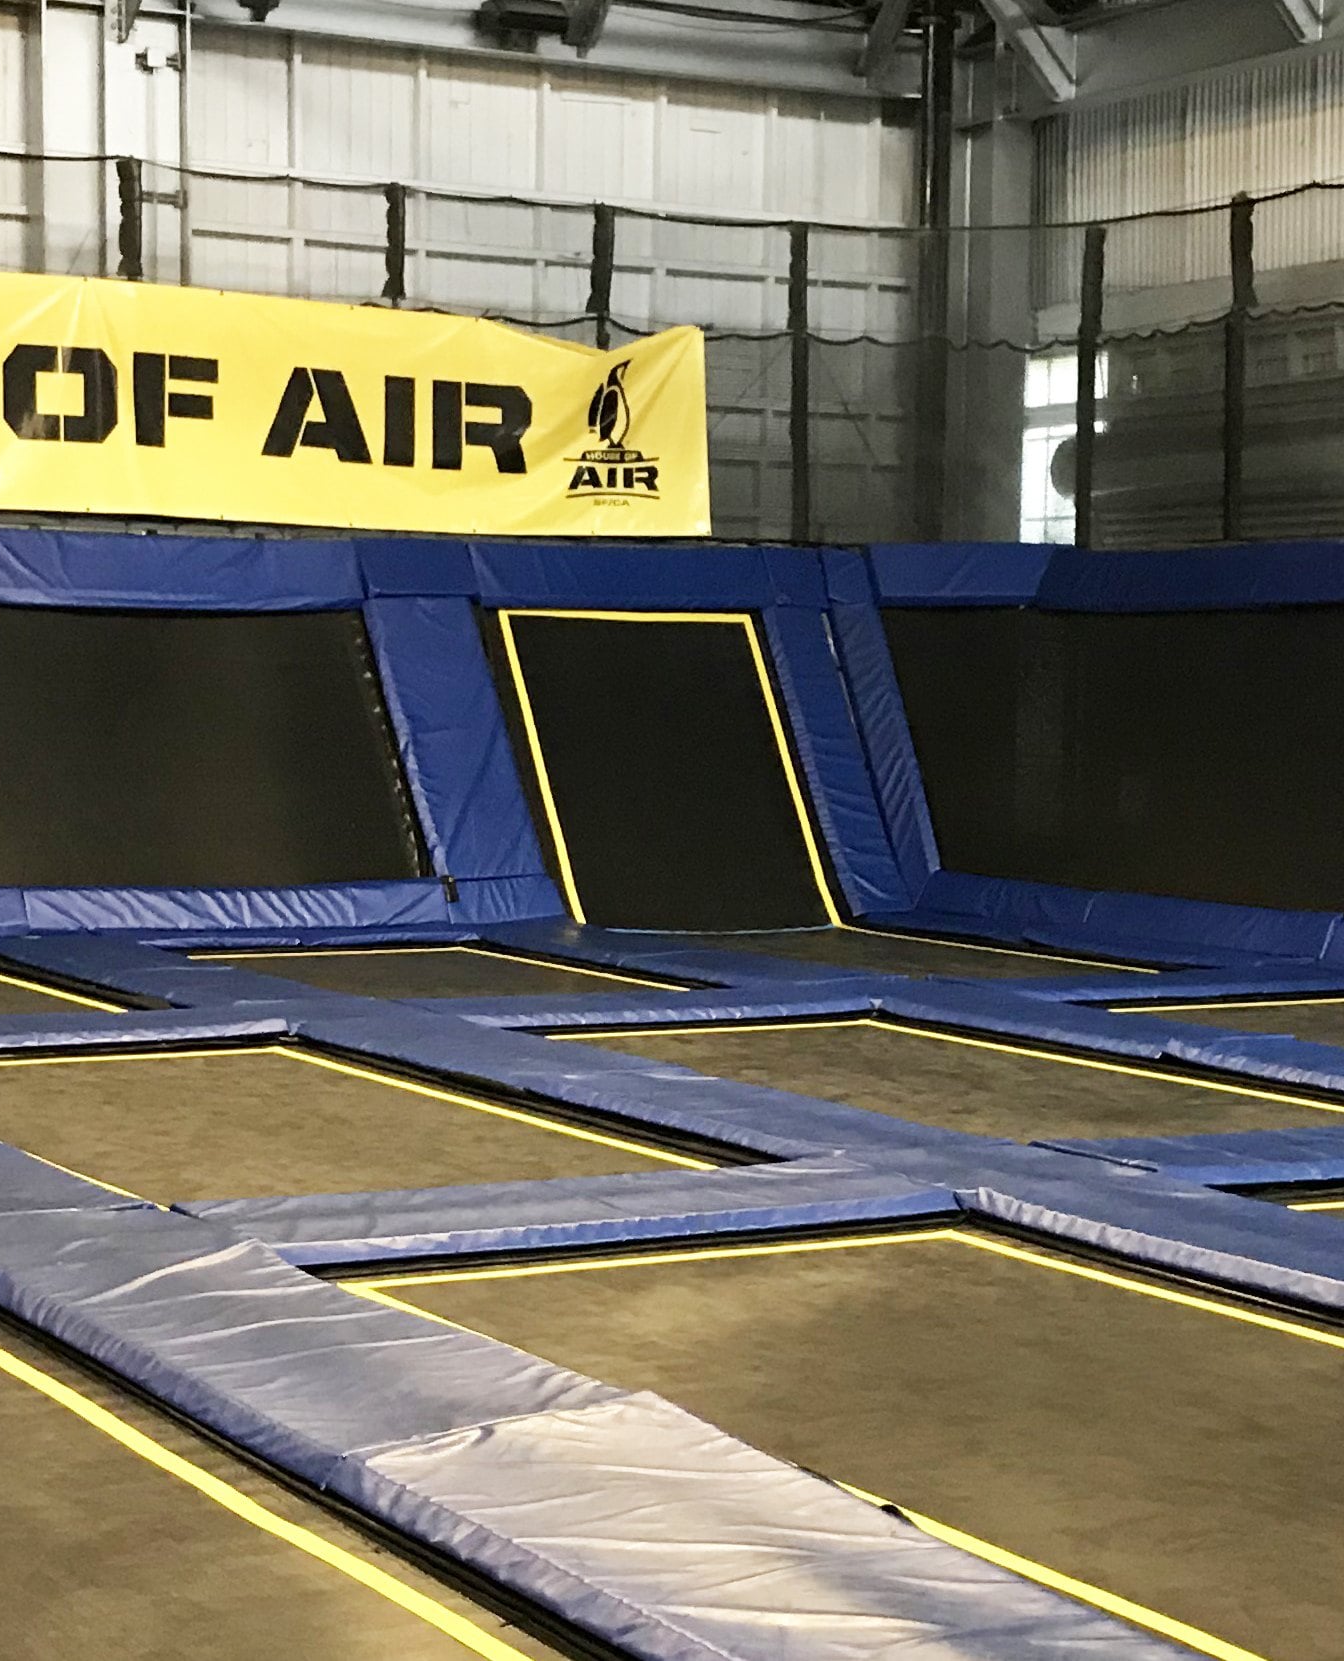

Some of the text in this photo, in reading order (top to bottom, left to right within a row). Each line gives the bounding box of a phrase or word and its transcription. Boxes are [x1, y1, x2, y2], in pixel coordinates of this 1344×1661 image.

[3, 344, 219, 447] OF
[261, 367, 533, 473] AIR
[568, 466, 659, 490] AIR
